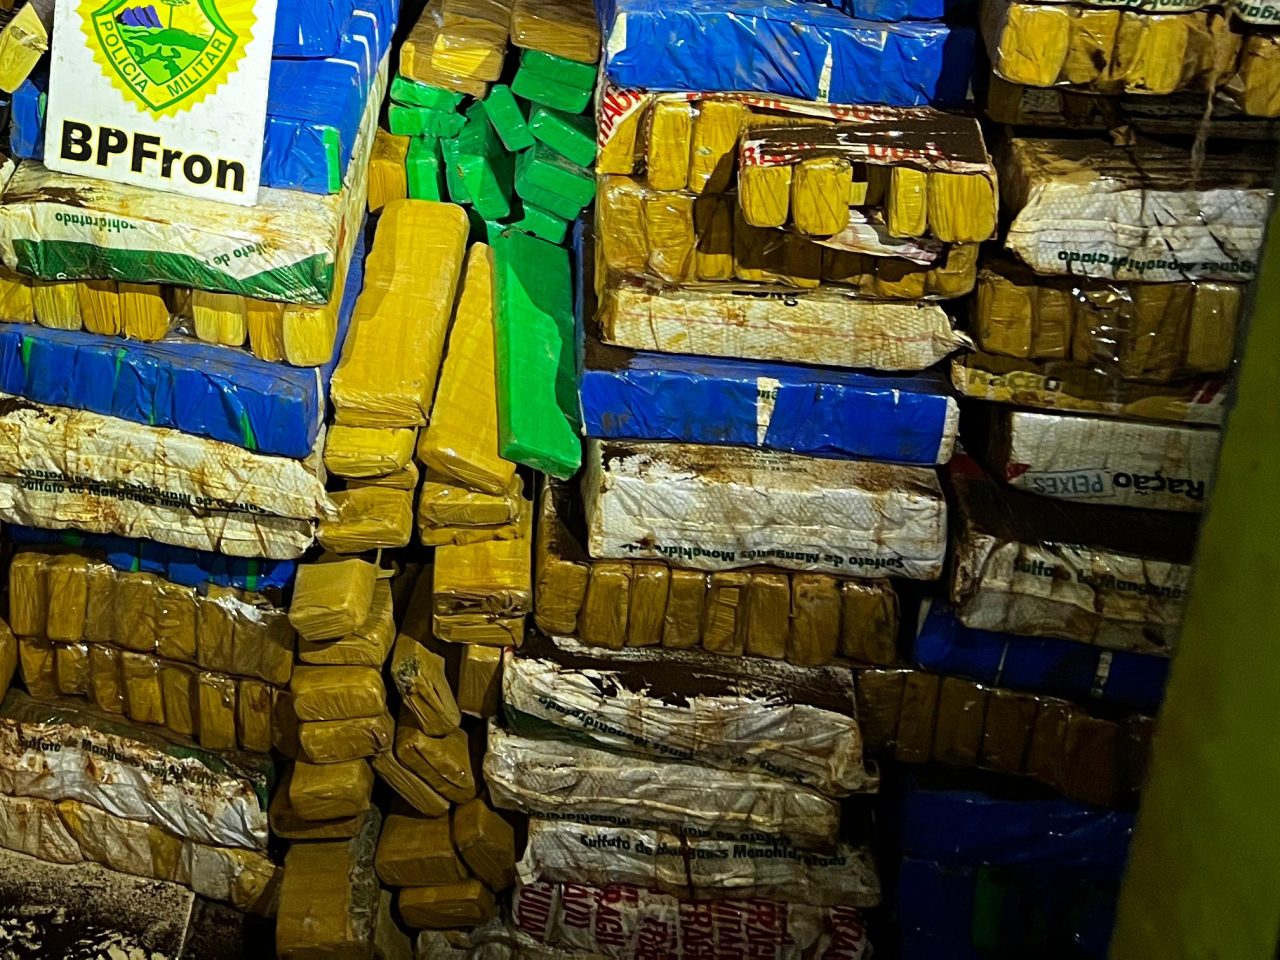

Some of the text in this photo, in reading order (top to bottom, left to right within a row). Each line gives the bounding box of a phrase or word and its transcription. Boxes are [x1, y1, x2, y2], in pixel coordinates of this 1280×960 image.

[99, 21, 227, 98] POLÍCIA MILITAR
[60, 120, 245, 192] BPFron
[1034, 471, 1205, 500] Ração PEIXES
[579, 833, 631, 852] Sulfato
[635, 840, 654, 855] de
